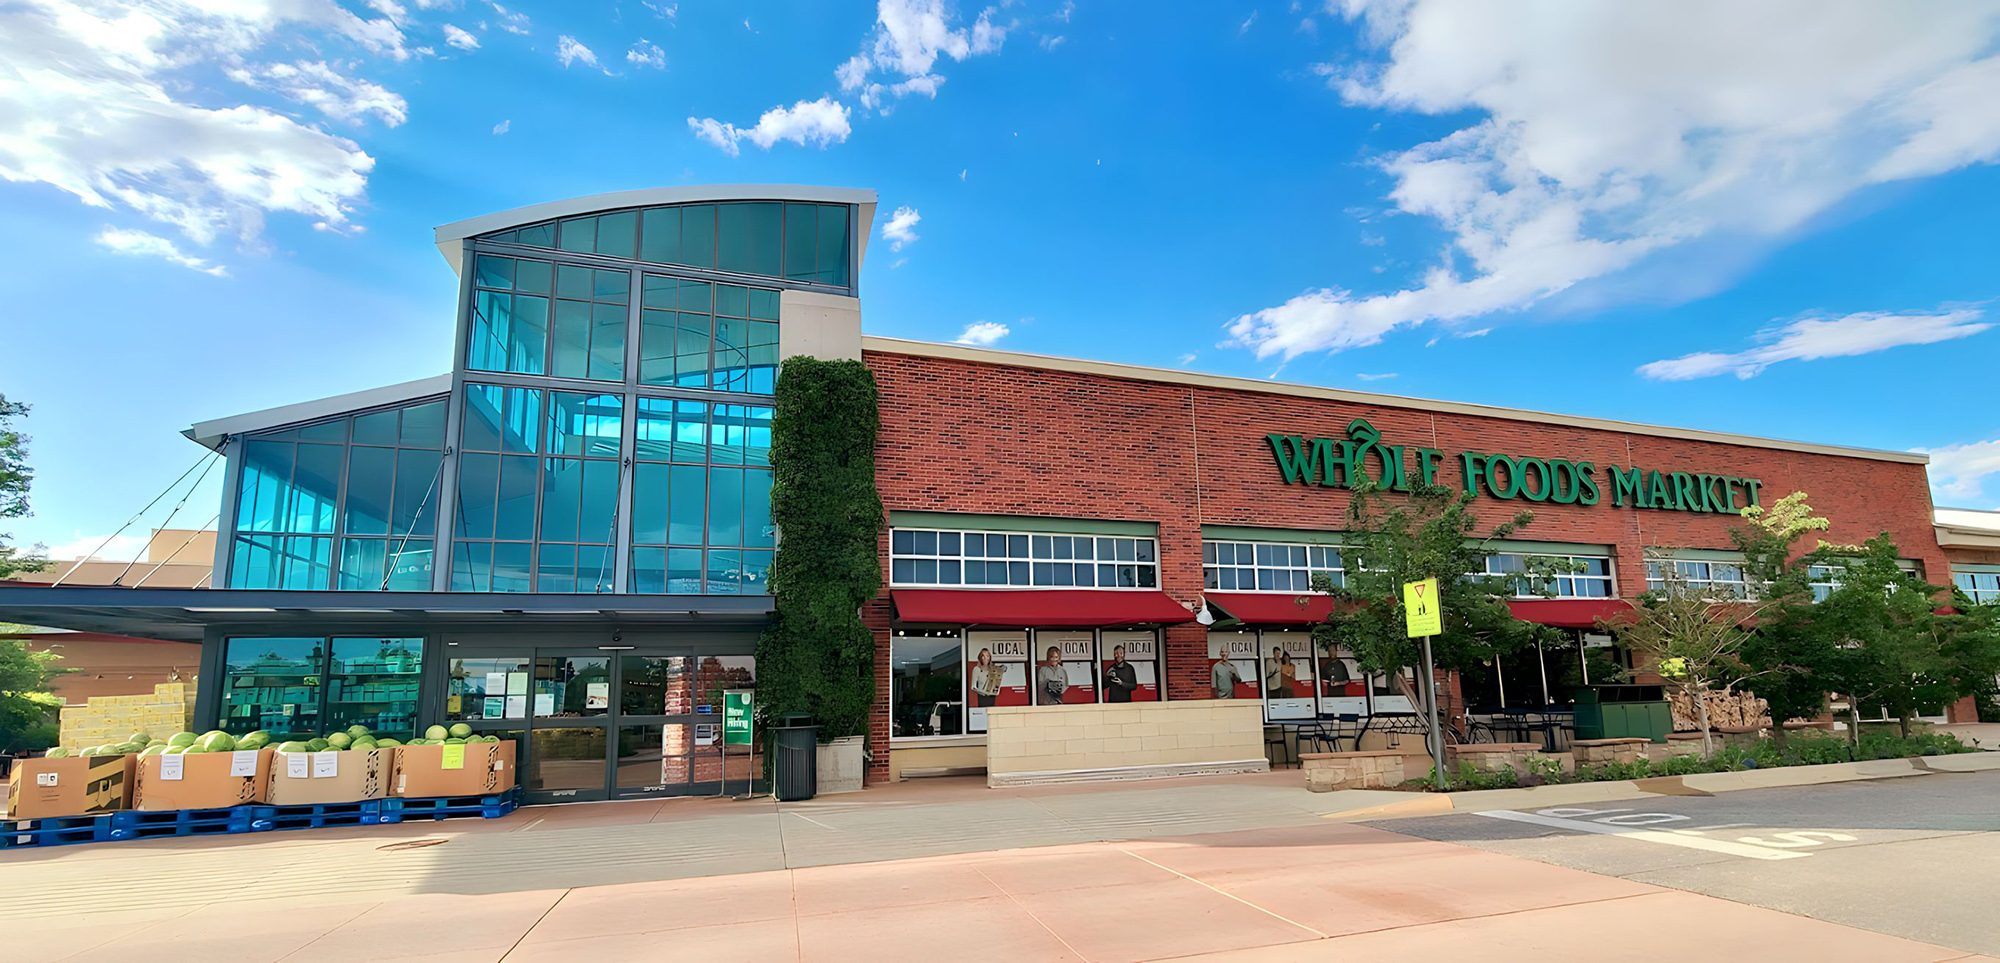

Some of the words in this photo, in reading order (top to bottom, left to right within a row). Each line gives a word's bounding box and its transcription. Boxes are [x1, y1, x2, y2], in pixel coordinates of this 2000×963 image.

[1266, 419, 1445, 491] WHOLE
[1458, 451, 1601, 506] FOODS
[1609, 465, 1763, 516] MARKET
[992, 642, 1025, 655] LOCAL
